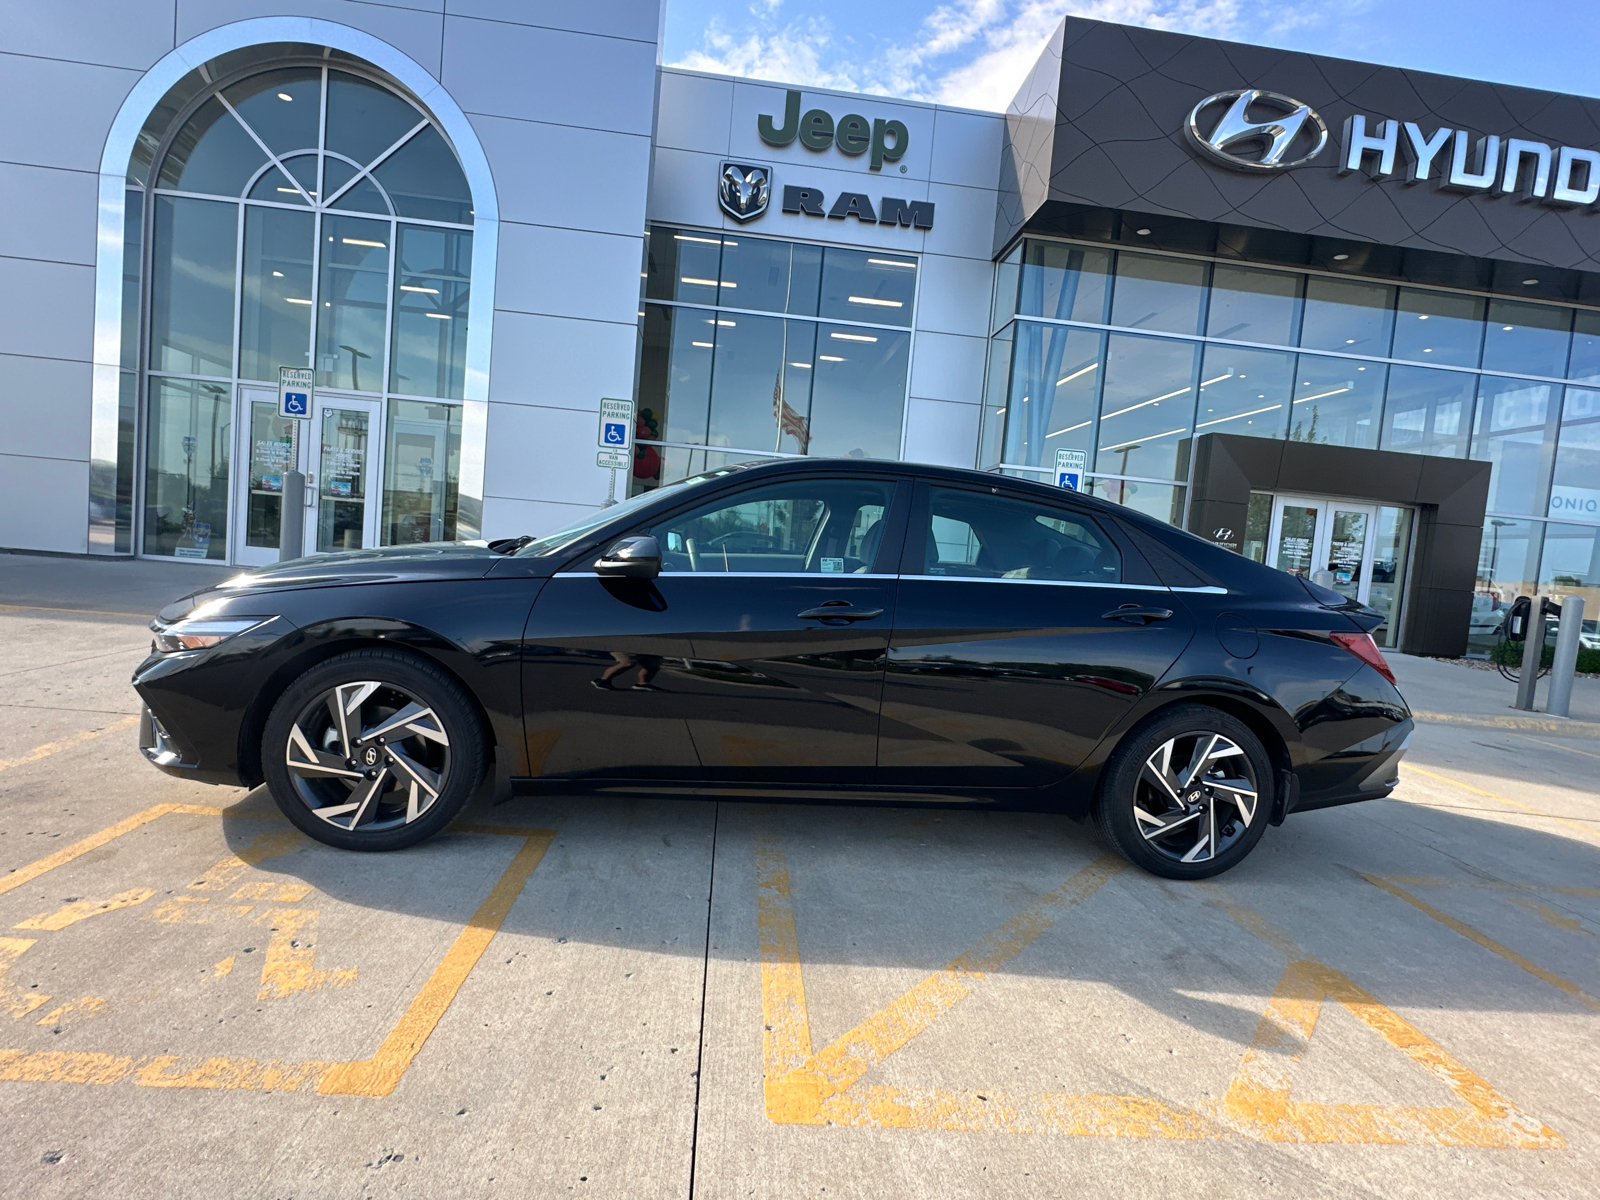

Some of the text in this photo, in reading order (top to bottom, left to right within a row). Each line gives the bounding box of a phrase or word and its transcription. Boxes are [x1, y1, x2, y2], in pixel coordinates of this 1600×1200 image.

[757, 89, 909, 171] Jeep
[782, 184, 936, 230] RAM
[282, 371, 312, 380] RESERVED
[282, 380, 312, 389] PARKING
[603, 402, 630, 411] RESERVED
[602, 411, 630, 420] PARKING
[1059, 453, 1083, 461] RESERVED
[1058, 461, 1082, 470] PARKING
